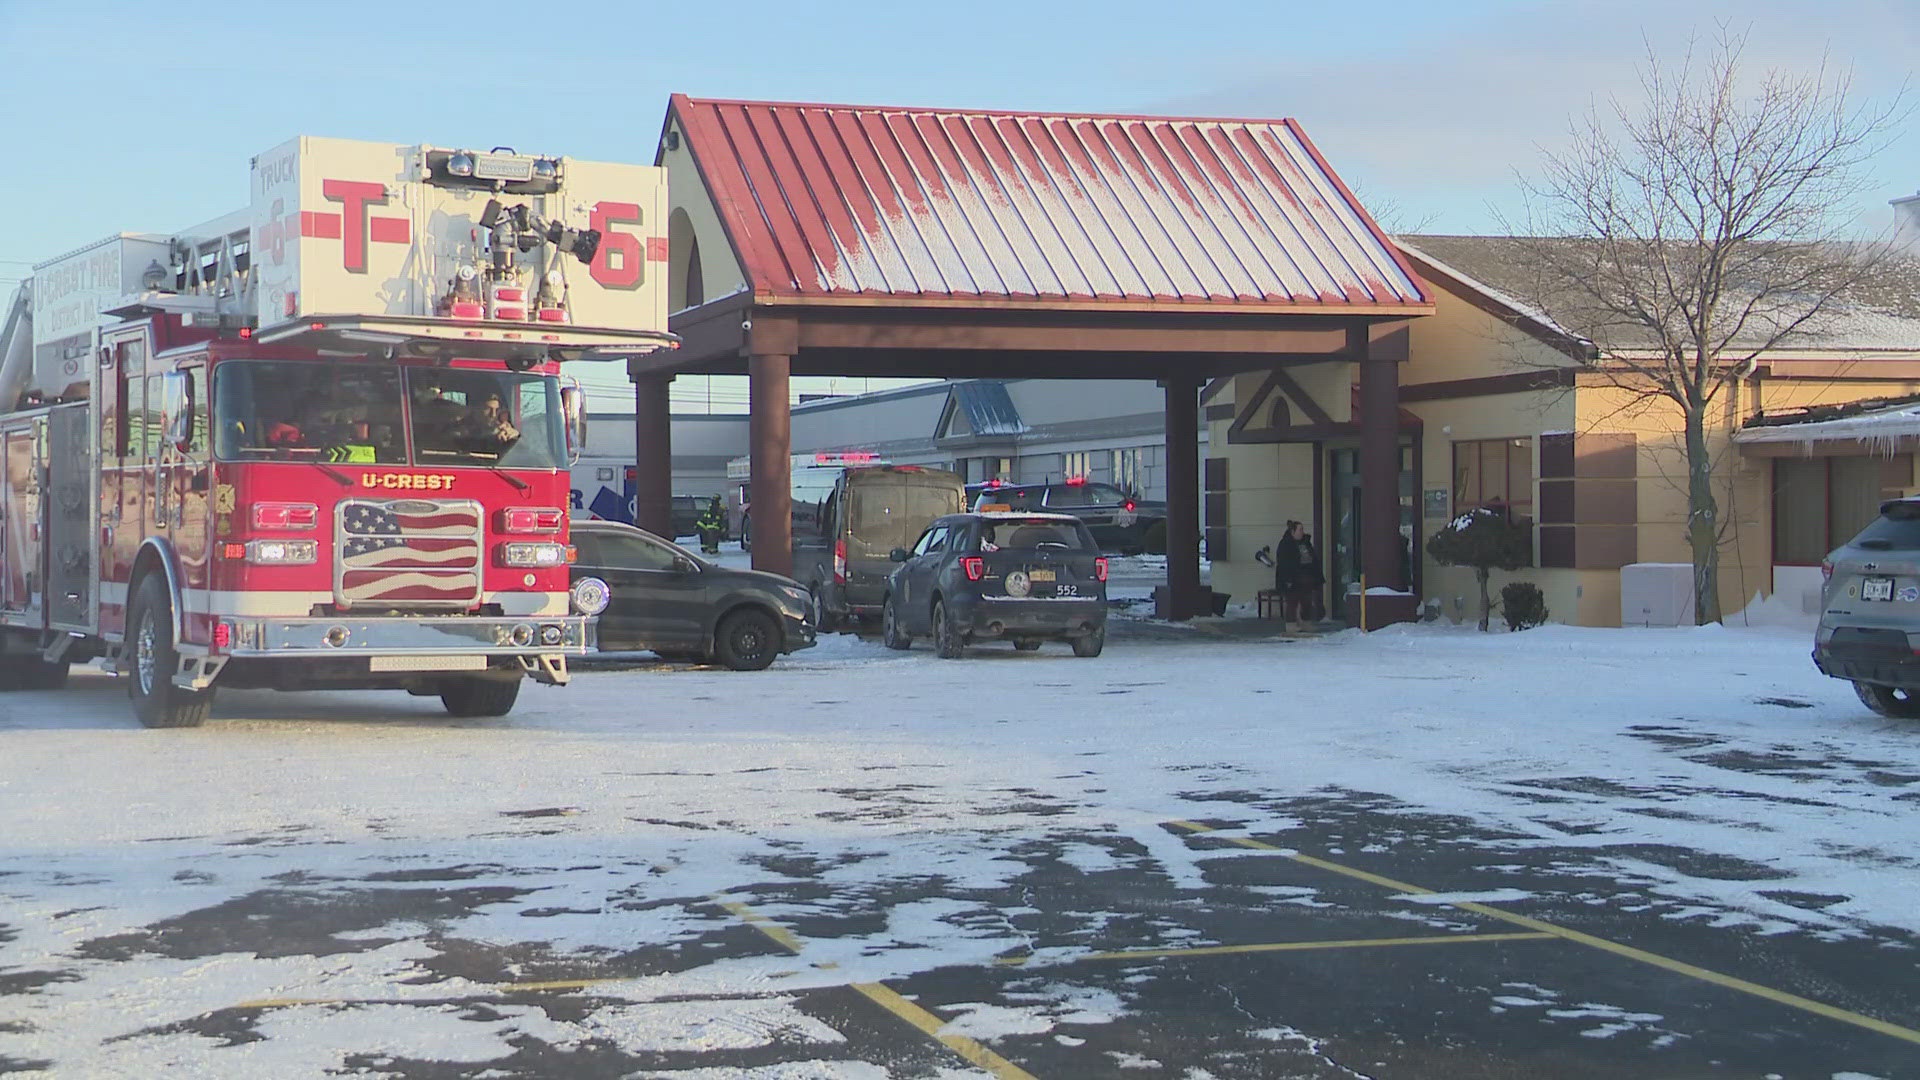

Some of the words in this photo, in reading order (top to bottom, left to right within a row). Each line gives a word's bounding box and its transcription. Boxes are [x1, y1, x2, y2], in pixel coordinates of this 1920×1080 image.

[260, 153, 296, 196] TRUCK
[270, 197, 286, 267] 6
[589, 201, 646, 292] 6
[90, 249, 121, 290] FIRE
[219, 493, 227, 504] 4
[1056, 584, 1078, 597] 552
